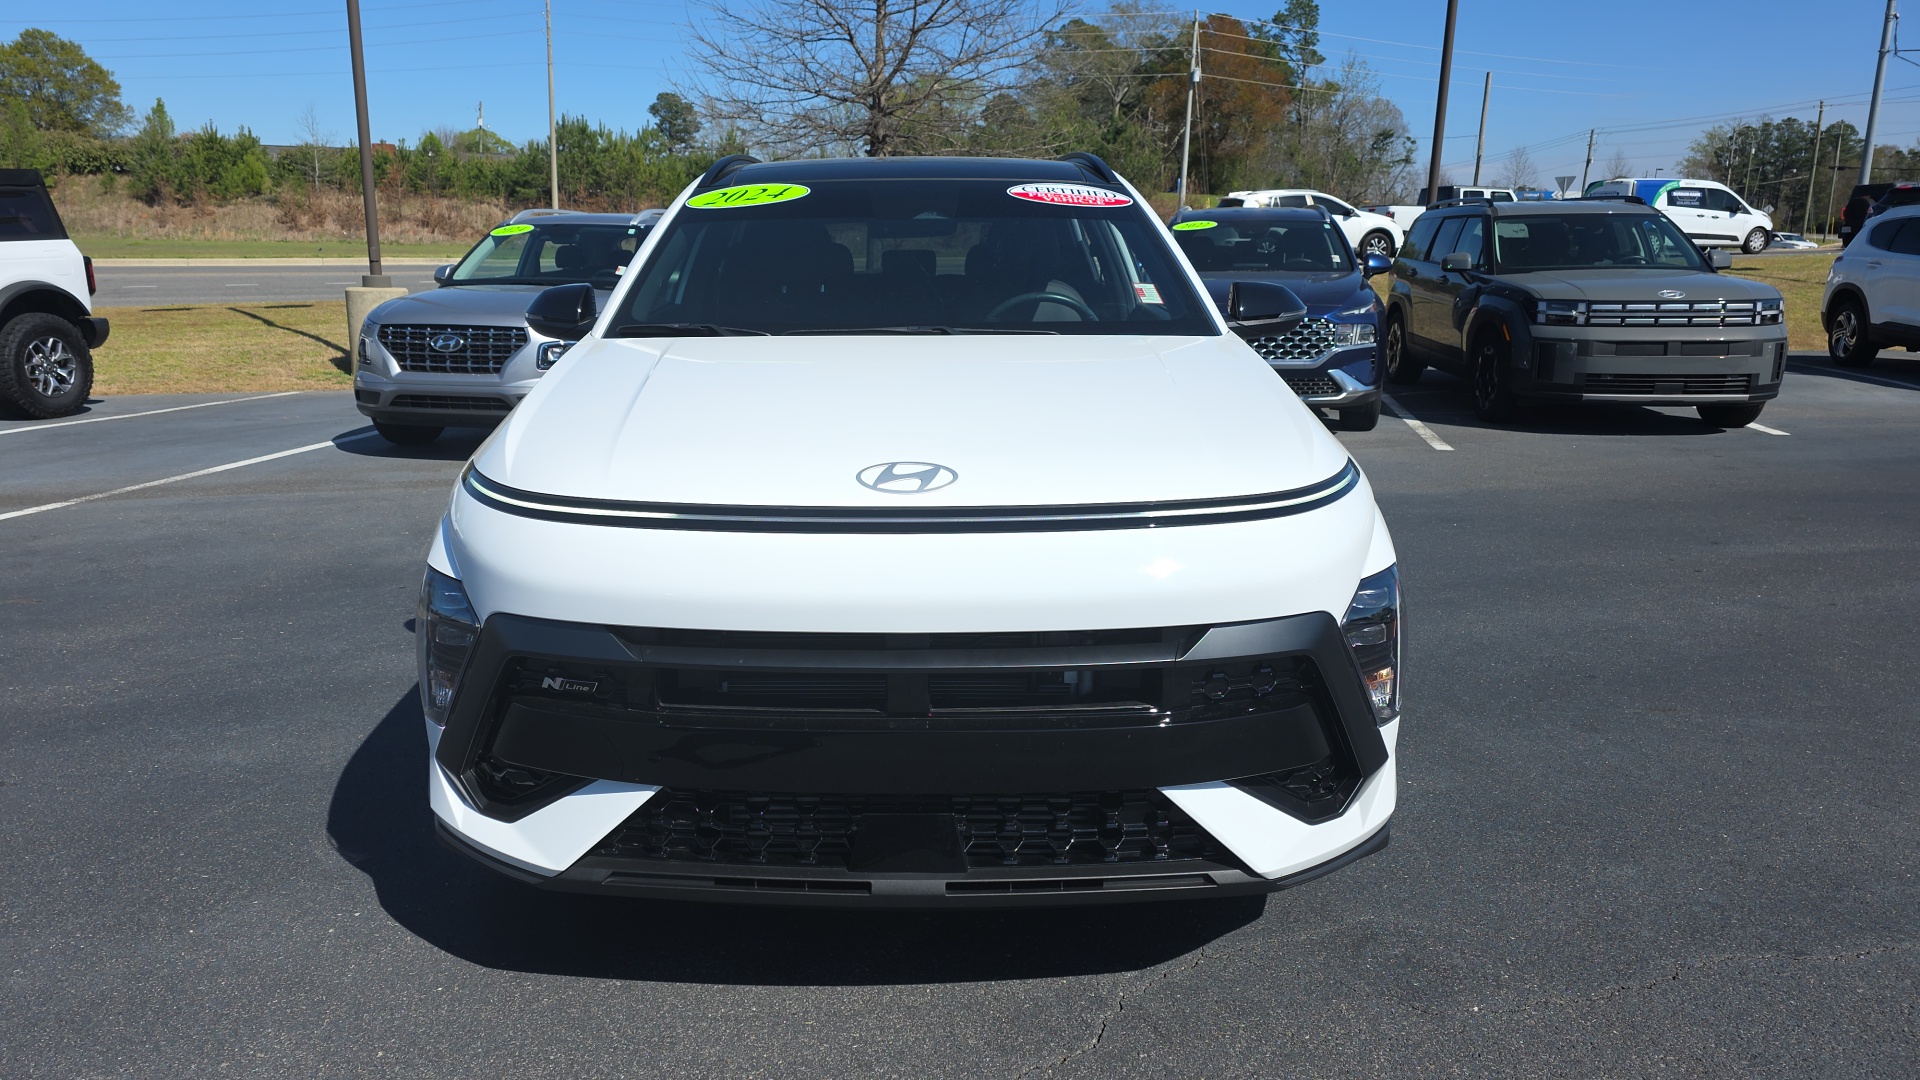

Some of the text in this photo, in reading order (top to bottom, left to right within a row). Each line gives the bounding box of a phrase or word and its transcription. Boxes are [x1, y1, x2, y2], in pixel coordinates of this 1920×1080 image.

[703, 187, 792, 205] 2024
[1021, 186, 1117, 198] CERTIFIED
[1028, 191, 1116, 203] PRE-OWNED
[1042, 194, 1106, 206] VEHICLE
[565, 683, 590, 692] Line
